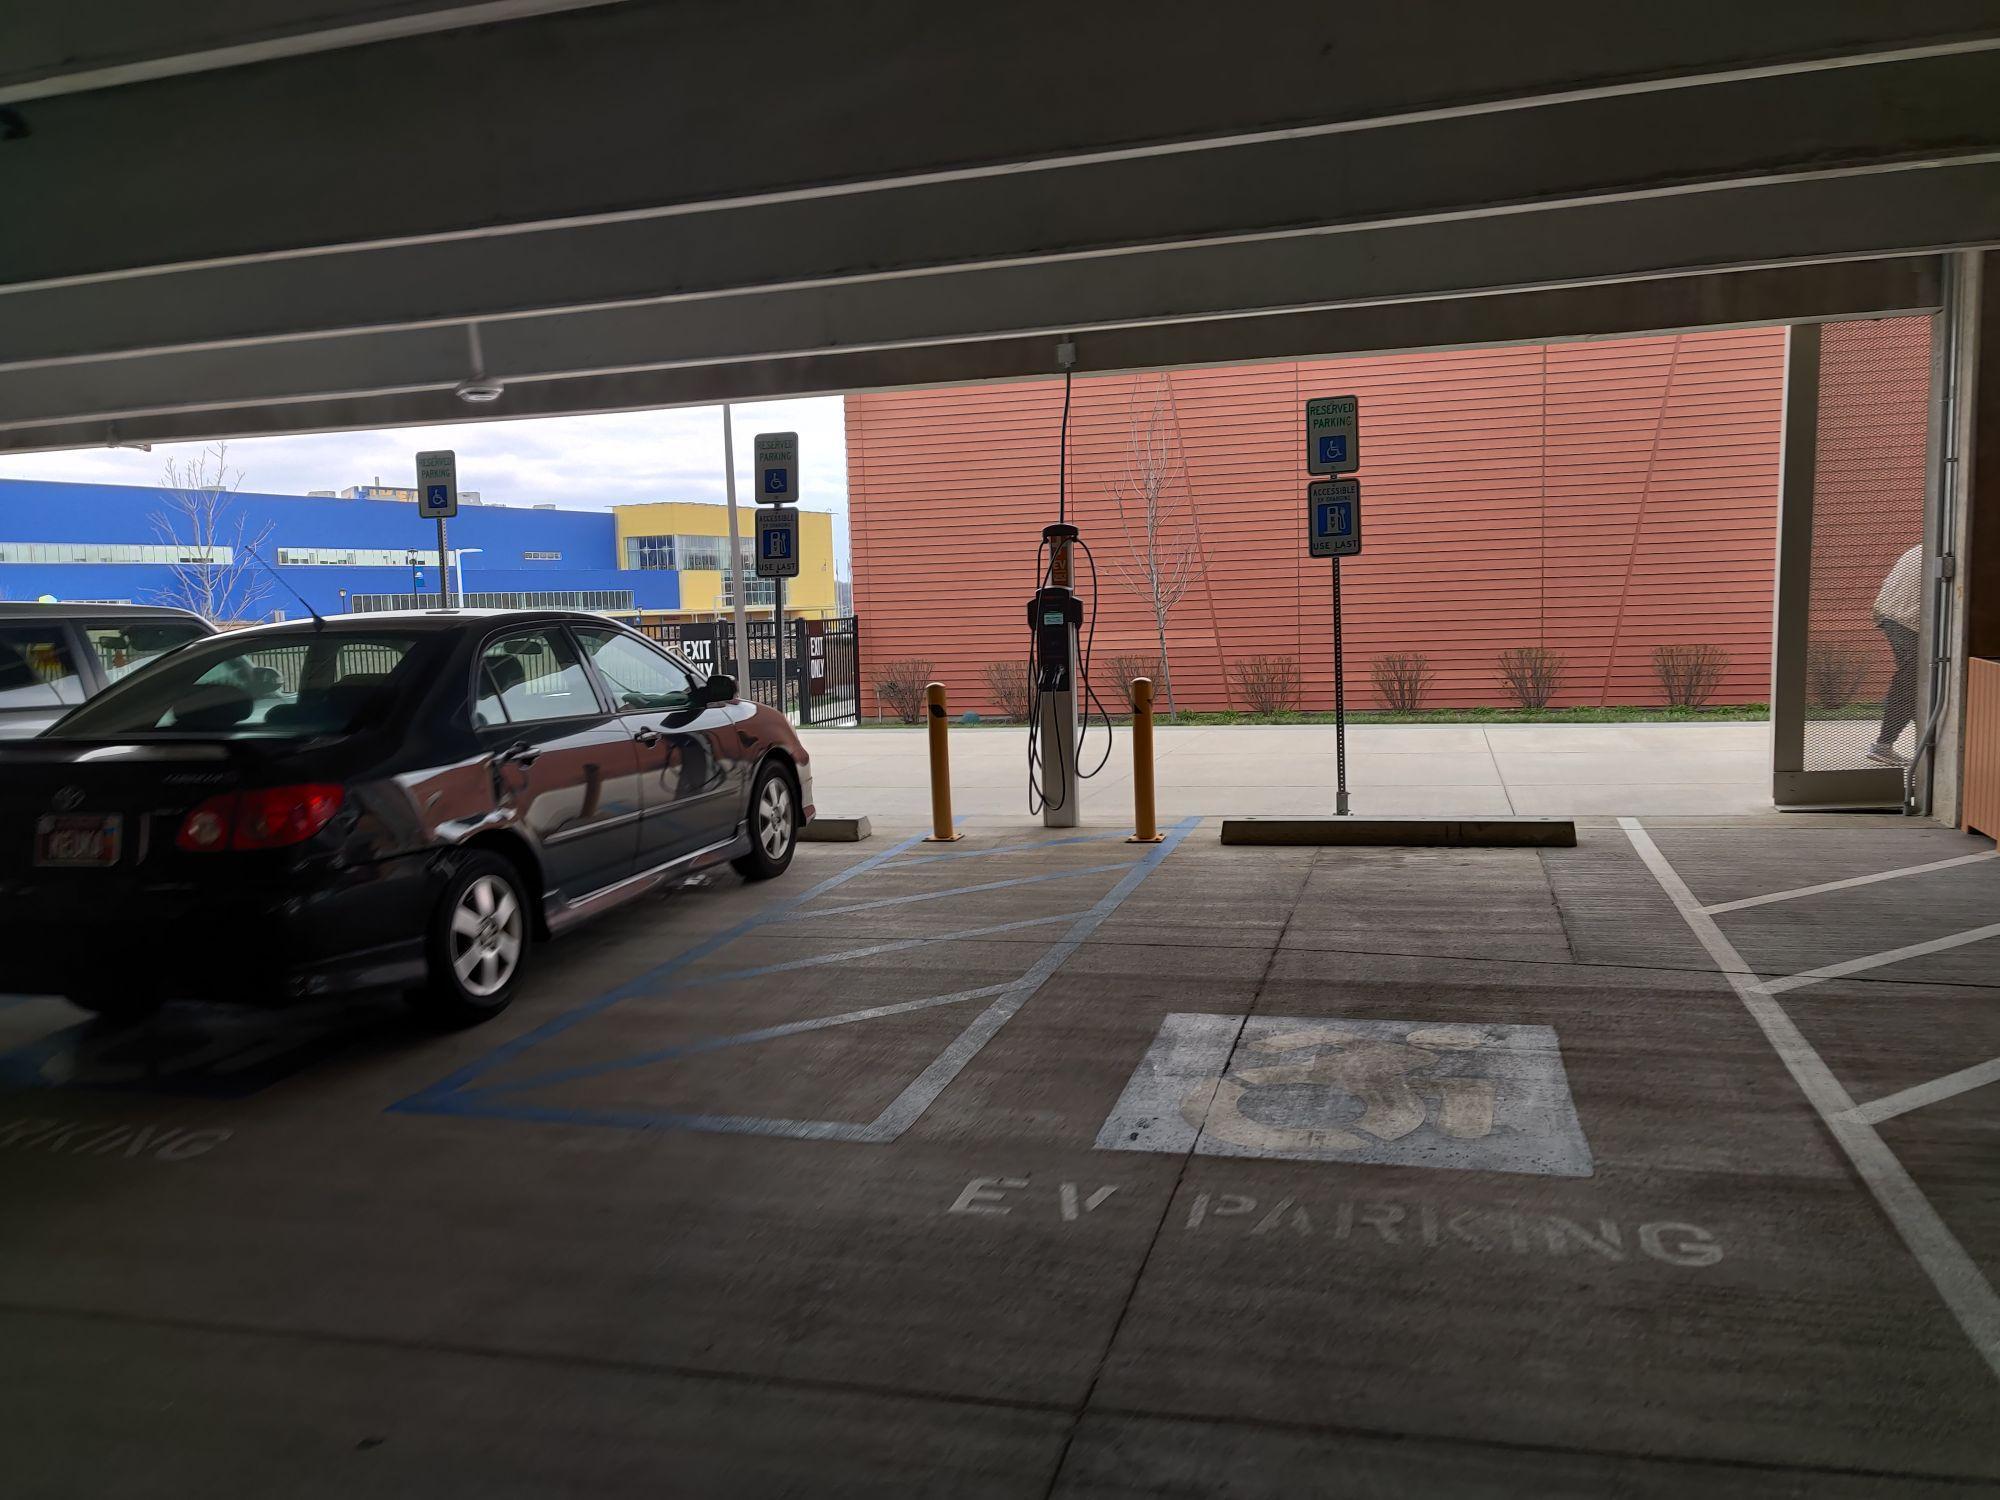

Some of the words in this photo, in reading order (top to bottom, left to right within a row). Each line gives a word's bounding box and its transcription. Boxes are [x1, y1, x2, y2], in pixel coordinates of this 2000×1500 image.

[1310, 402, 1354, 416] RESERVED
[1313, 416, 1352, 429] PARKING
[759, 452, 792, 462] PARKING
[1313, 485, 1356, 497] ACCESSIBLE
[1313, 542, 1330, 550] USE
[1335, 540, 1358, 549] LAST
[759, 563, 774, 571] USE
[777, 562, 795, 571] LAST
[683, 639, 712, 660] EXIT
[810, 636, 824, 656] EXIT
[810, 658, 825, 678] ONLY
[945, 1174, 1122, 1222] EV
[1184, 1190, 1725, 1267] PARKING
